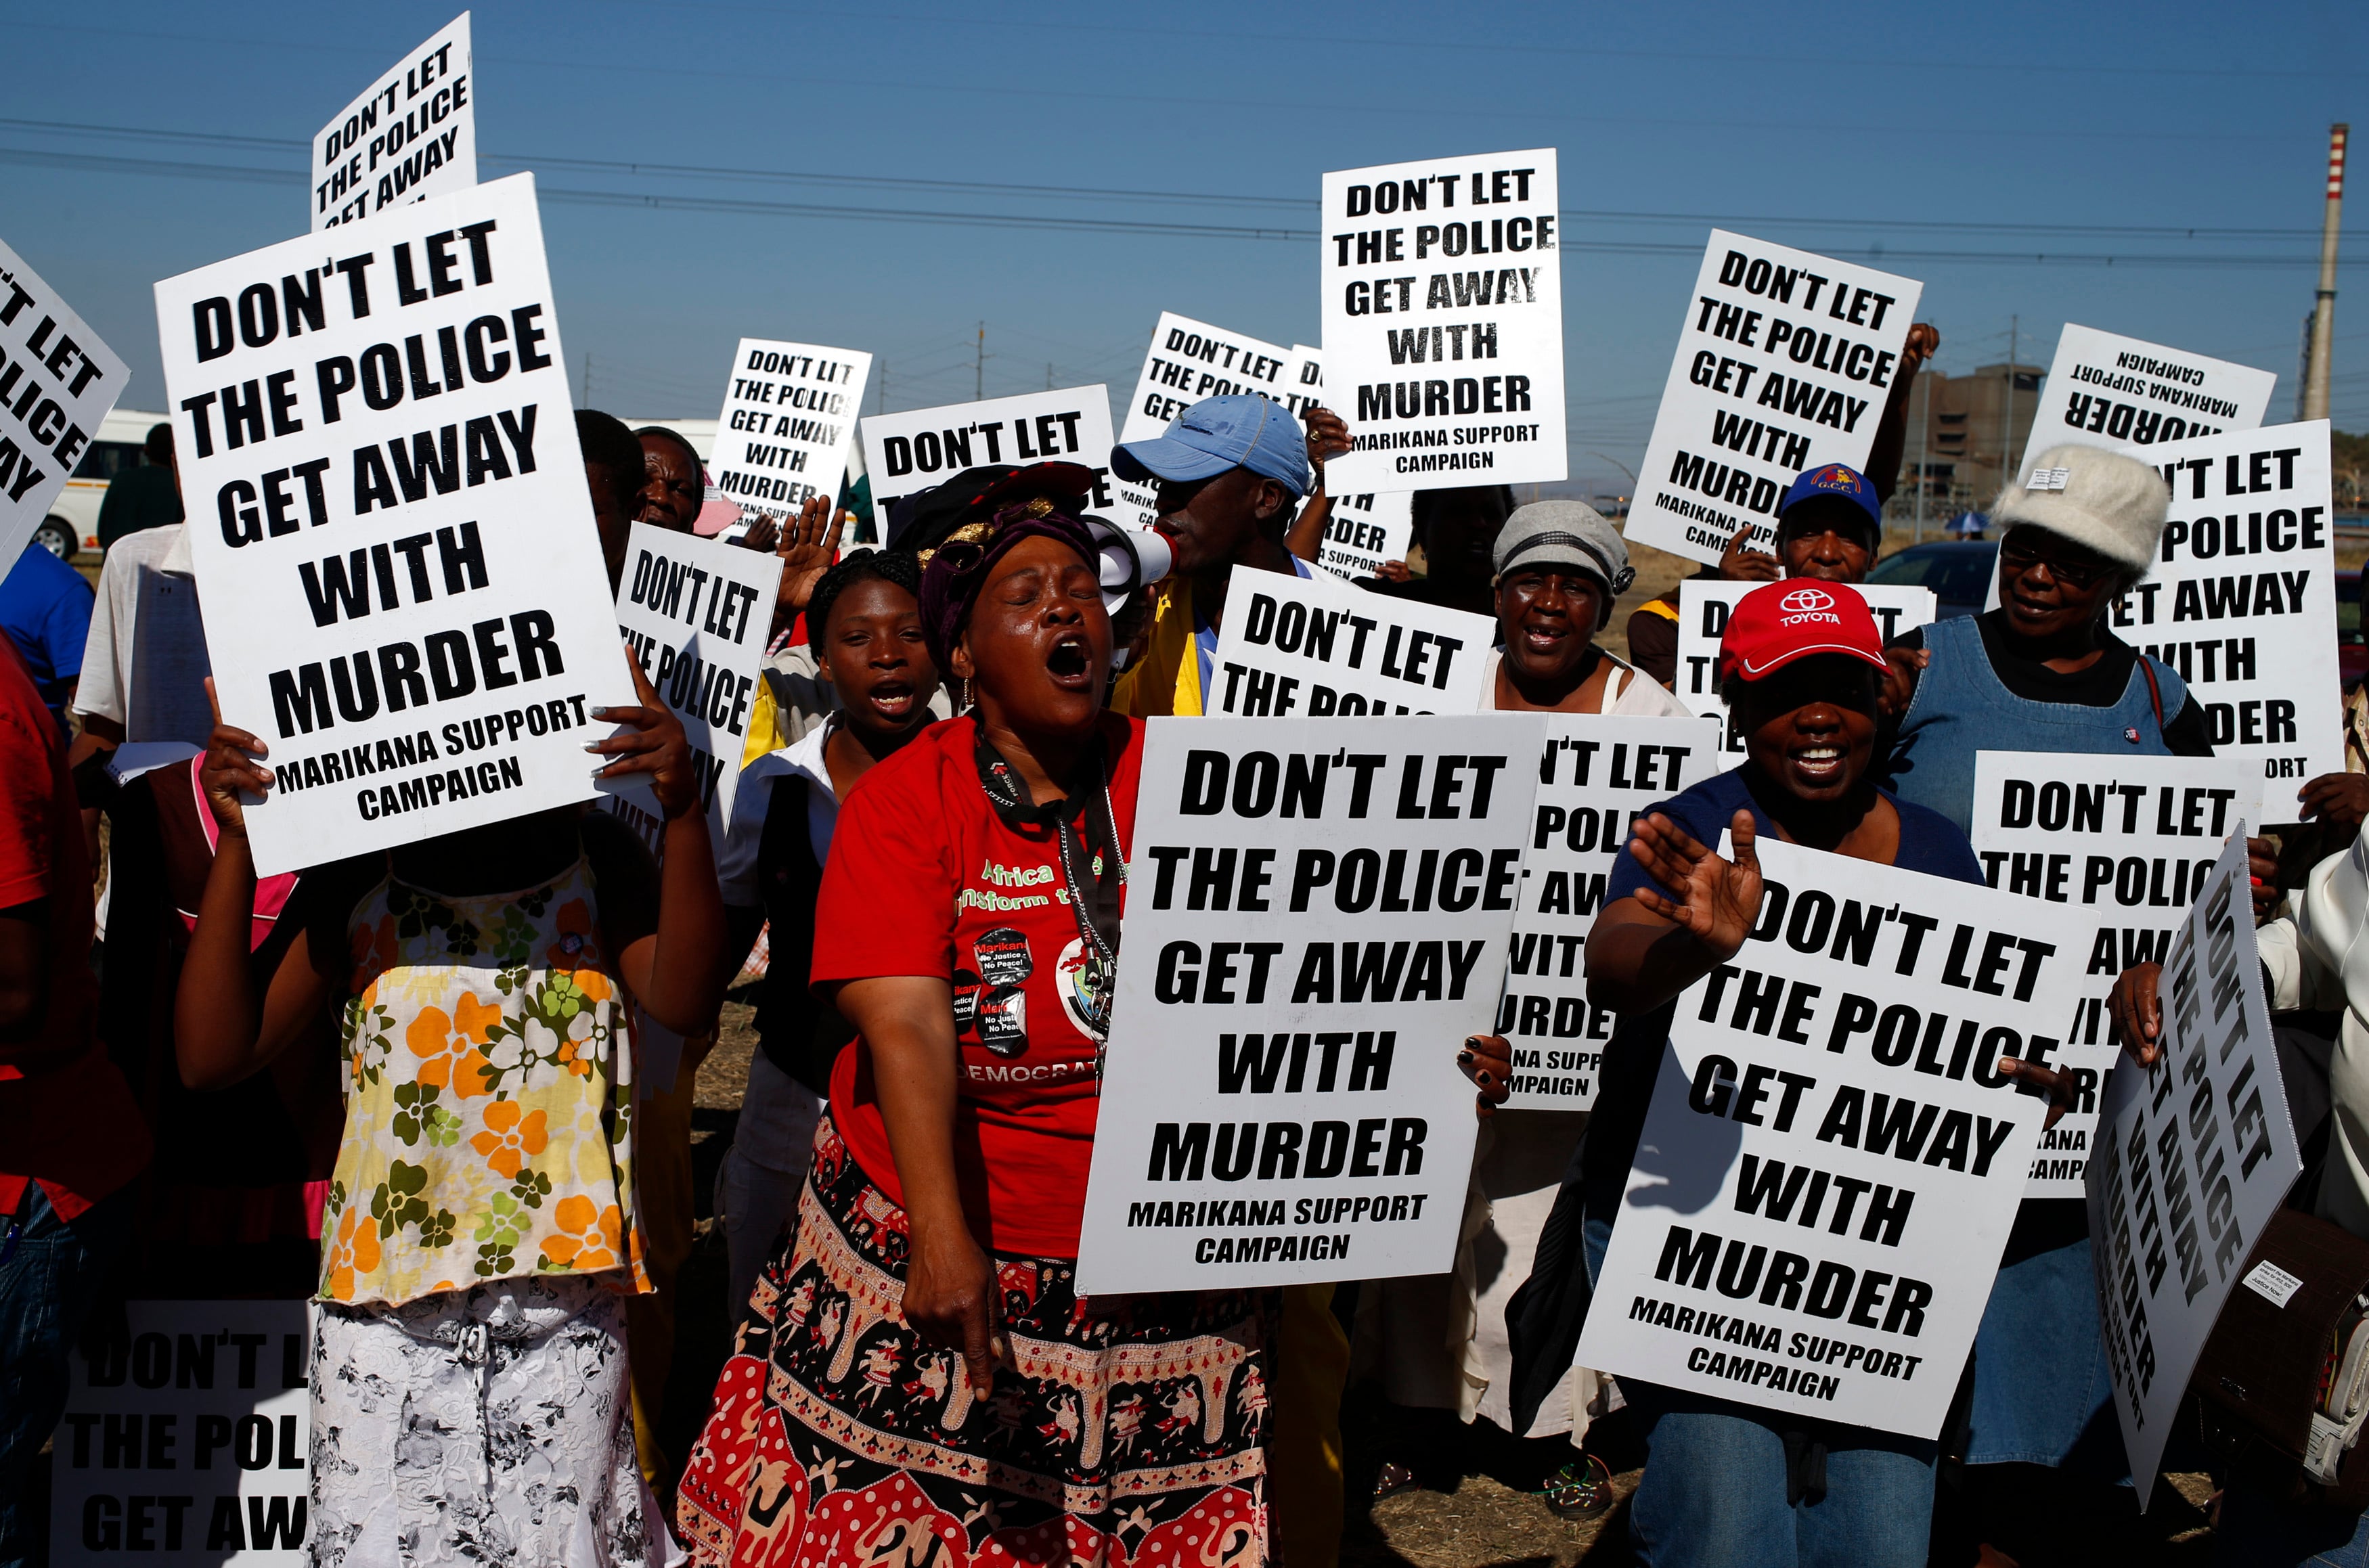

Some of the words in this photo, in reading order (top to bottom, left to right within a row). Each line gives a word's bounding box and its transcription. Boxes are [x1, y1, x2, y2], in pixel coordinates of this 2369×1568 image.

[326, 81, 399, 166] DON'T
[407, 42, 451, 100] LET
[317, 153, 361, 213] THE
[370, 75, 466, 172] POLICE
[376, 121, 458, 211] AWAY
[1347, 174, 1460, 217] DON'T
[1472, 169, 1534, 204] LET
[1333, 228, 1404, 267] THE
[1417, 216, 1554, 259] POLICE
[193, 252, 374, 363] DON'T
[393, 220, 496, 307] LET
[1346, 277, 1416, 316] GET
[1427, 268, 1536, 309] AWAY
[1719, 250, 1828, 311] DON'T
[1829, 283, 1895, 330] LET
[26, 315, 103, 399] LET
[747, 351, 813, 377] DON'T
[1166, 328, 1239, 368] DON'T
[1240, 352, 1283, 382] LET
[1388, 323, 1497, 365] WITH
[1697, 296, 1762, 347] THE
[1765, 319, 1895, 388] POLICE
[2117, 352, 2204, 386] CAMPAIGN
[181, 369, 303, 459] THE
[316, 304, 551, 424] POLICE
[734, 379, 774, 403] THE
[1150, 358, 1194, 391] THE
[1358, 376, 1530, 421] MURDER
[1690, 351, 1758, 398] GET
[1757, 372, 1868, 433] AWAY
[2071, 365, 2146, 395] SUPPORT
[2150, 383, 2238, 418] MARIKANA
[0, 344, 89, 472] LICE
[730, 410, 772, 433] GET
[774, 416, 843, 446] AWAY
[746, 443, 807, 472] WITH
[884, 422, 1003, 476] DON'T
[1015, 411, 1081, 459] LET
[1352, 428, 1448, 453] MARIKANA
[1454, 424, 1539, 445] SUPPORT
[1396, 451, 1492, 473] CAMPAIGN
[1712, 409, 1811, 472] WITH
[218, 457, 330, 547] GET
[354, 404, 537, 515] AWAY
[1669, 449, 1792, 520] MURD
[2226, 448, 2301, 495] LET
[1656, 493, 1736, 533] MARIKANA
[2162, 507, 2324, 562] POLICE
[298, 521, 489, 627] WITH
[631, 550, 708, 625] DON'T
[704, 576, 759, 644] LET
[2112, 583, 2161, 627] ET
[2173, 570, 2309, 622] AWAY
[1244, 593, 1377, 669] DON'T
[1381, 625, 1463, 690] LET
[1780, 612, 1841, 627] TOYOTA
[269, 610, 571, 750] MURDER
[655, 644, 753, 737] POLICE
[1222, 661, 1300, 716] THE
[275, 731, 439, 794] MARIKANA
[442, 694, 586, 755] SUPPORT
[2206, 699, 2297, 746] DER
[357, 756, 523, 820] CAMPAIGN
[1180, 747, 1386, 819] DON'T
[1396, 755, 1507, 819] LET
[1540, 735, 1599, 785] N'T
[1610, 744, 1691, 791] LET
[1534, 805, 1640, 853] POL
[2001, 780, 2146, 834] DON'T
[2157, 787, 2235, 837] LET
[981, 859, 1055, 887] Africa
[1149, 847, 1276, 912] THE
[1289, 849, 1521, 913] POLICE
[1537, 872, 1609, 916] AW
[1979, 851, 2071, 903] THE
[993, 952, 1021, 960] Justice
[997, 960, 1023, 968] Peace!
[1508, 933, 1588, 977] WIT
[1752, 878, 1939, 977] DON'T
[1941, 924, 2056, 1002] LET
[1155, 941, 1283, 1004] GET
[1291, 941, 1486, 1003] AWAY
[2172, 914, 2200, 1052] THE
[1698, 963, 1823, 1046] THE
[1828, 991, 2059, 1098] POLICE
[2205, 870, 2249, 1066] DON'T
[2228, 1055, 2272, 1183] LET
[1218, 1031, 1396, 1094] WITH
[1507, 1075, 1589, 1096] MPAIGN
[1547, 1050, 1601, 1071] SUPP
[1687, 1054, 1816, 1132] GET
[1816, 1085, 2015, 1177] AWAY
[1147, 1118, 1427, 1182] MURDER
[2175, 1033, 2242, 1285] POLICE
[1128, 1200, 1285, 1227] MARIKANA
[1294, 1194, 1427, 1224] SUPPORT
[1734, 1153, 1915, 1247] WITH
[2127, 1108, 2167, 1299] WITH
[2157, 1114, 2208, 1307] AWAY
[1195, 1234, 1350, 1263] CAMPAIGN
[2104, 1122, 2155, 1399] MURDER
[1654, 1226, 1932, 1349] MURDER
[2252, 1277, 2270, 1289] Justice
[2269, 1286, 2283, 1298] Now!
[1629, 1297, 1781, 1353] MARIKANA
[1788, 1333, 1922, 1381] SUPPORT
[2112, 1297, 2146, 1432] SUPPORT
[1688, 1341, 1847, 1401] CAMPAIGN
[65, 1413, 177, 1469] THE
[194, 1414, 305, 1471] POL
[83, 1494, 193, 1551] GET
[206, 1496, 309, 1551] AW
